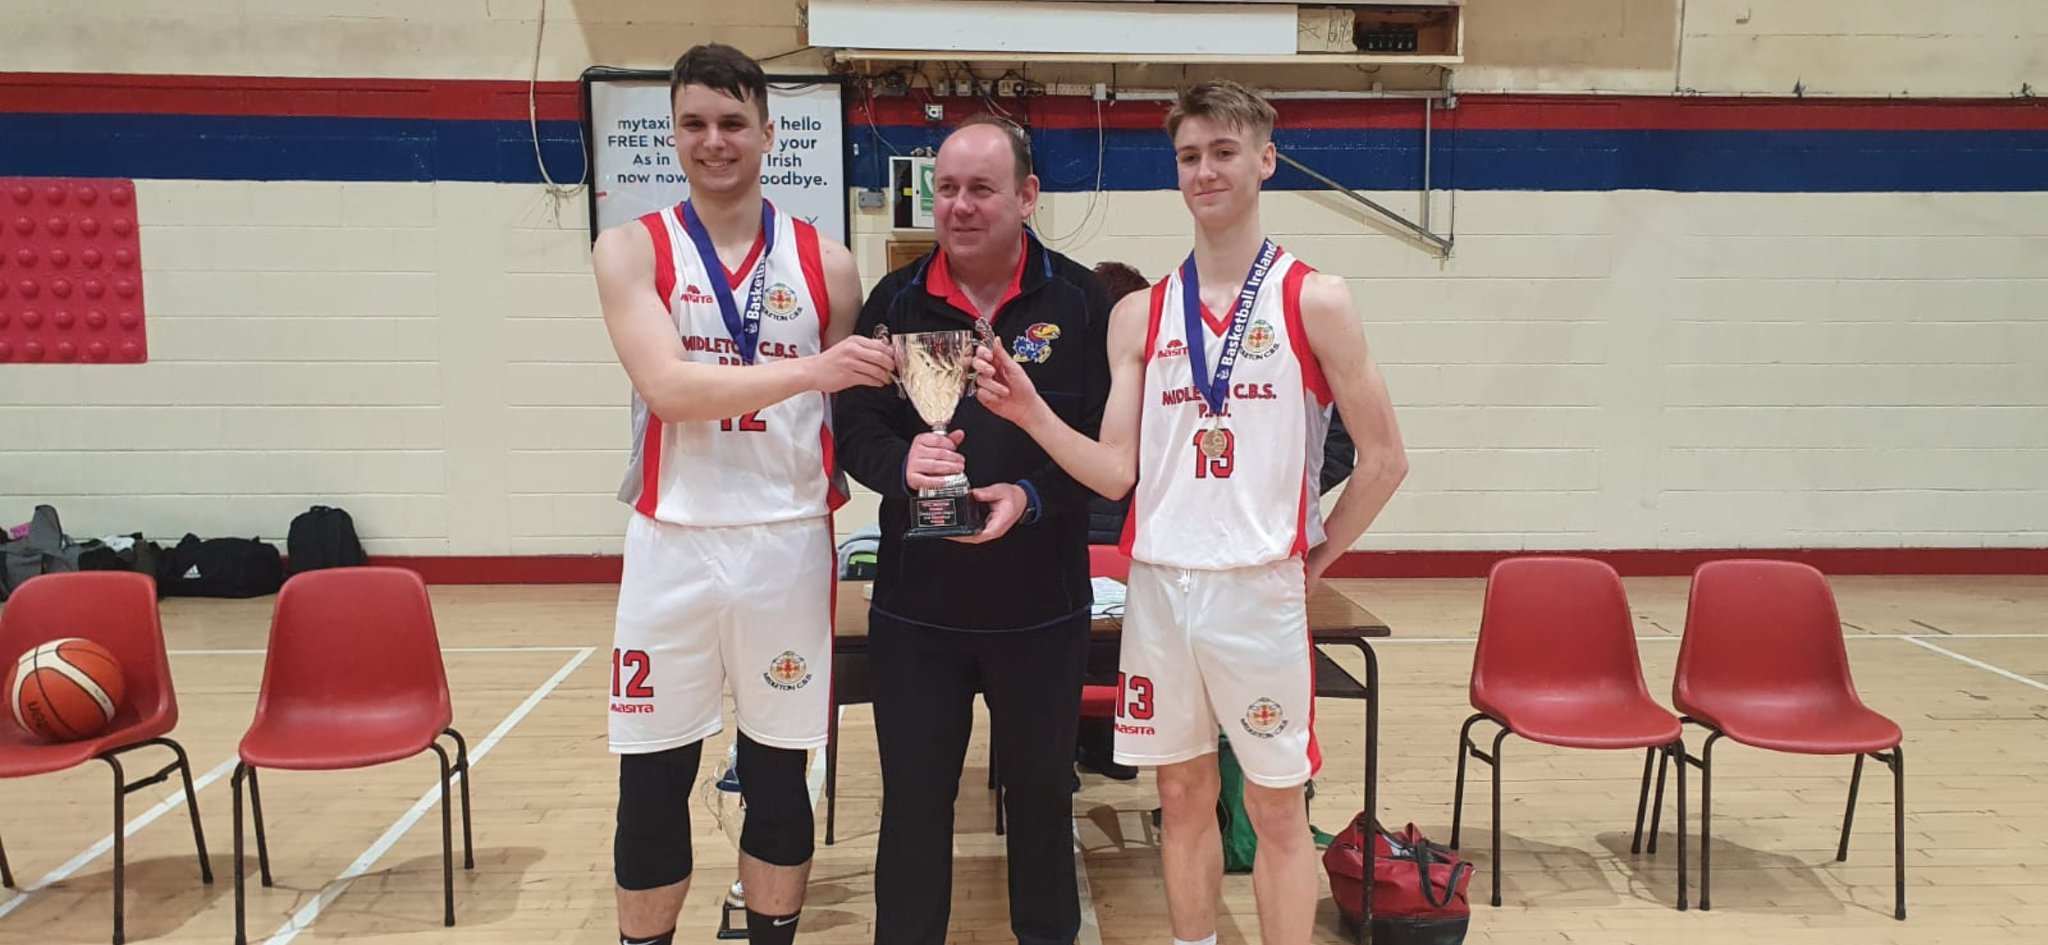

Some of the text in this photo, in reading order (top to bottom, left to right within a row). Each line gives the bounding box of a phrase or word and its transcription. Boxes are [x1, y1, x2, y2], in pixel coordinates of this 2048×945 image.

[618, 114, 822, 132] mytaxi hello
[608, 134, 818, 152] FREE NO your
[633, 152, 802, 167] As in Irish
[617, 174, 650, 183] now
[760, 170, 828, 189] oodbye.
[746, 262, 765, 320] Basketb
[1221, 241, 1278, 366] Basketball Ireland
[682, 335, 742, 354] MIDLETO
[1162, 383, 1277, 406] MIDLE C.B.S.
[1193, 428, 1234, 478] 13
[613, 648, 654, 698] 12
[1117, 671, 1154, 720] 13
